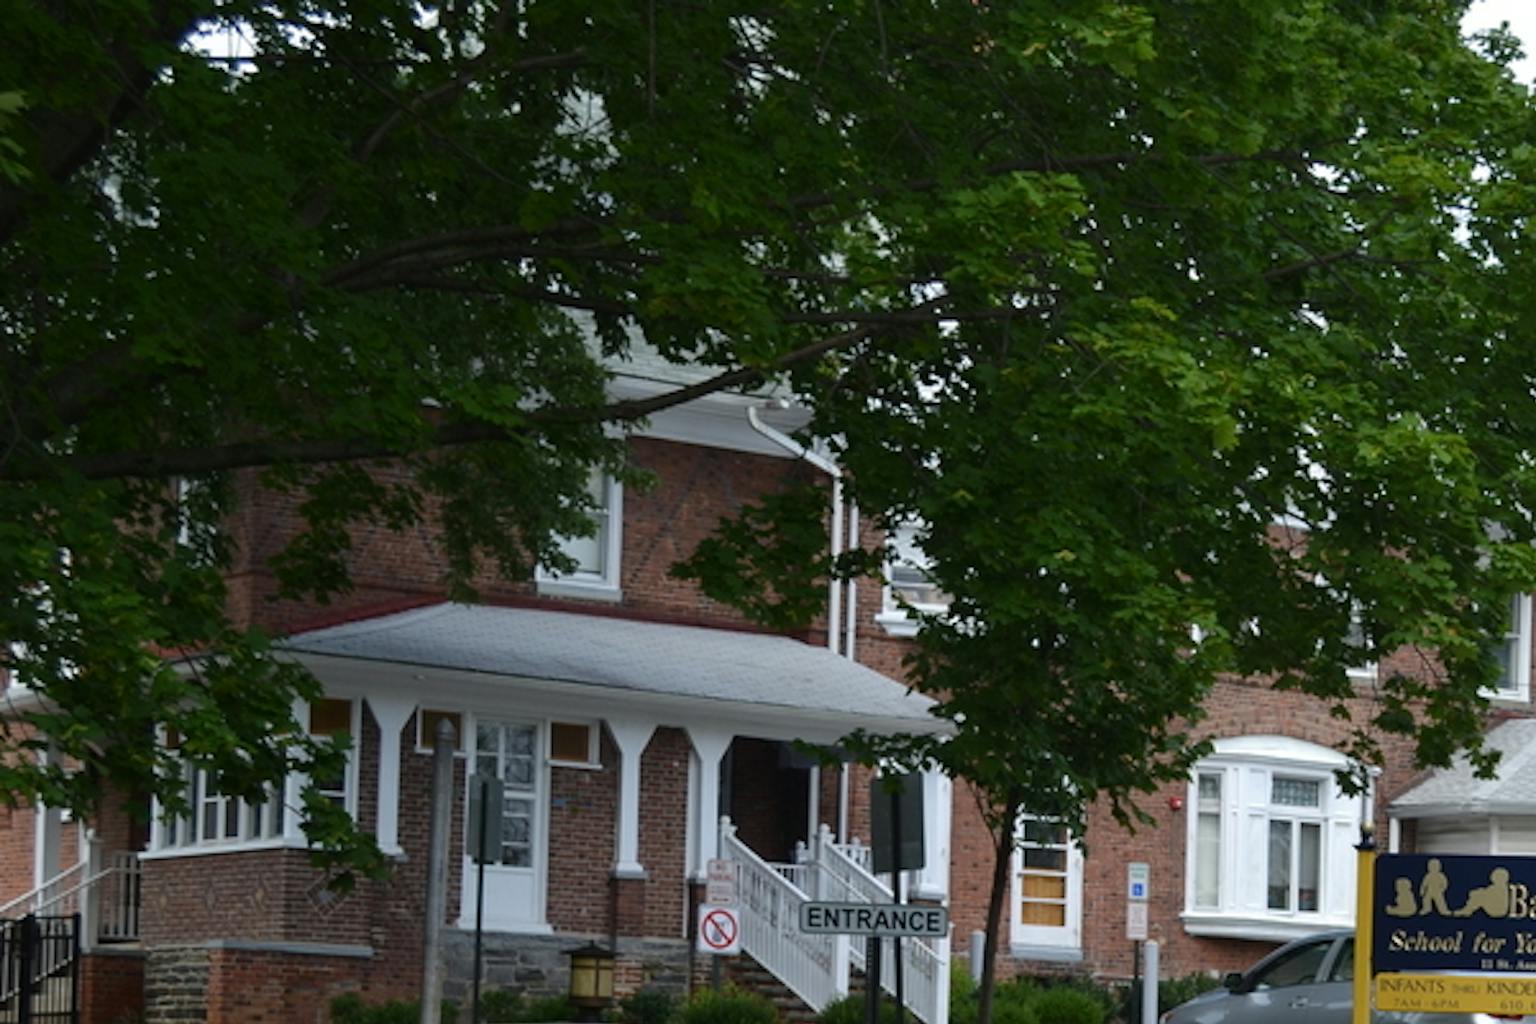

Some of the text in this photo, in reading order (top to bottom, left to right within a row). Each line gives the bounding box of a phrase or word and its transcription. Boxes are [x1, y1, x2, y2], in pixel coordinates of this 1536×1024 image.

[807, 906, 941, 932] ENTRANCE
[1389, 929, 1463, 952] School
[1472, 931, 1506, 953] for
[1381, 979, 1445, 994] INFANTS
